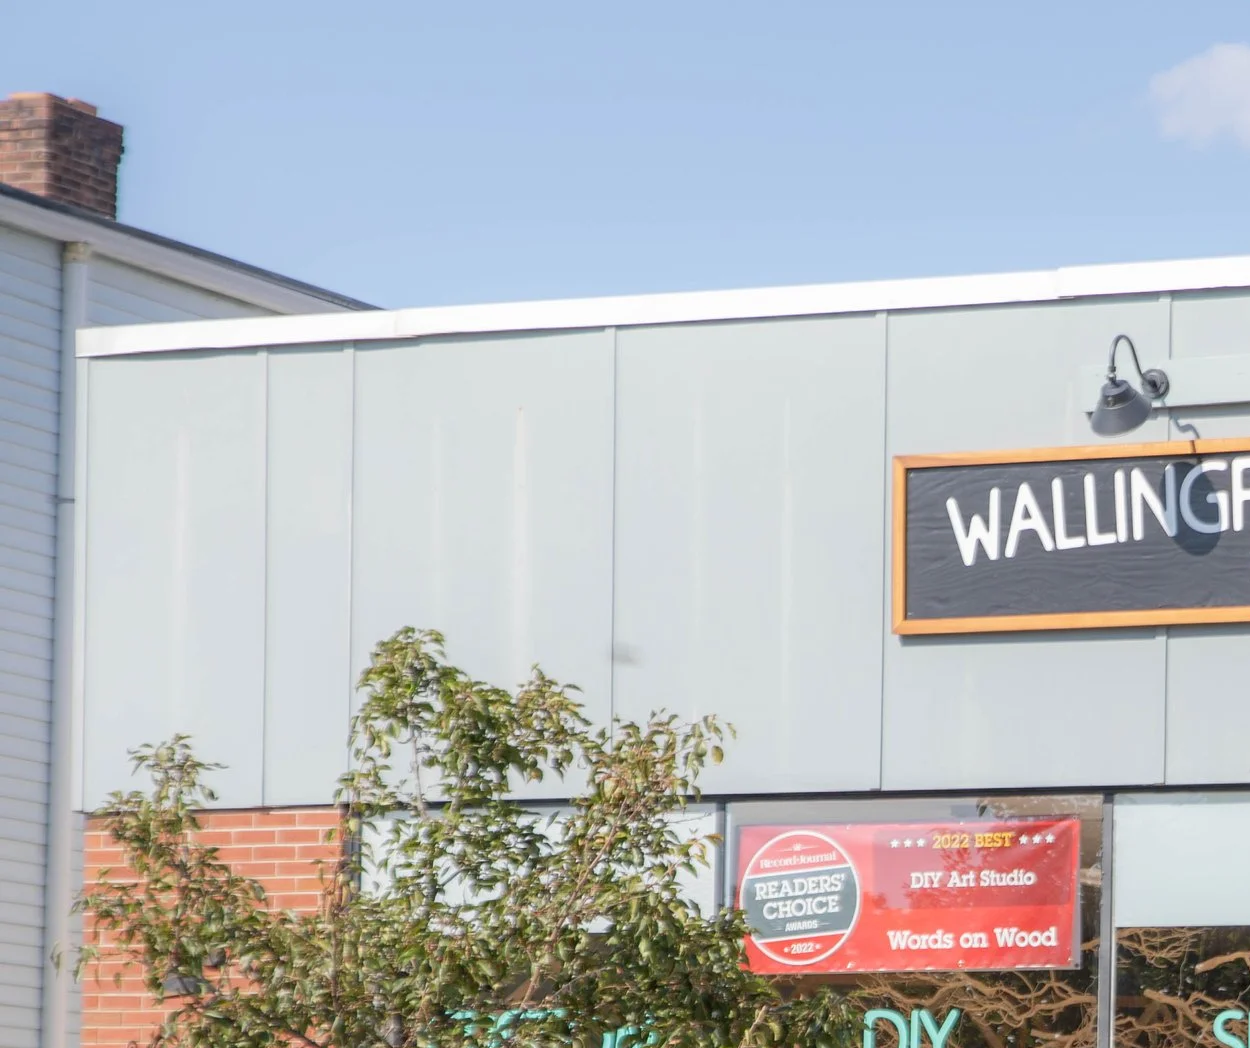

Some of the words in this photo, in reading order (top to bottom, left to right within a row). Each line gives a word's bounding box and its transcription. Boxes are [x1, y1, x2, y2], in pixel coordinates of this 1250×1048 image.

[932, 834, 970, 849] 2022
[974, 831, 1015, 848] BEST
[754, 872, 845, 900] READERS'
[910, 871, 943, 889] DIY
[947, 872, 977, 888] Art
[980, 869, 1037, 887] Studio
[762, 894, 840, 920] CHOICE
[784, 919, 819, 932] AWARDS
[790, 942, 814, 954] 2022
[887, 930, 953, 951] Words
[959, 932, 988, 949] on
[993, 926, 1059, 948] Wood
